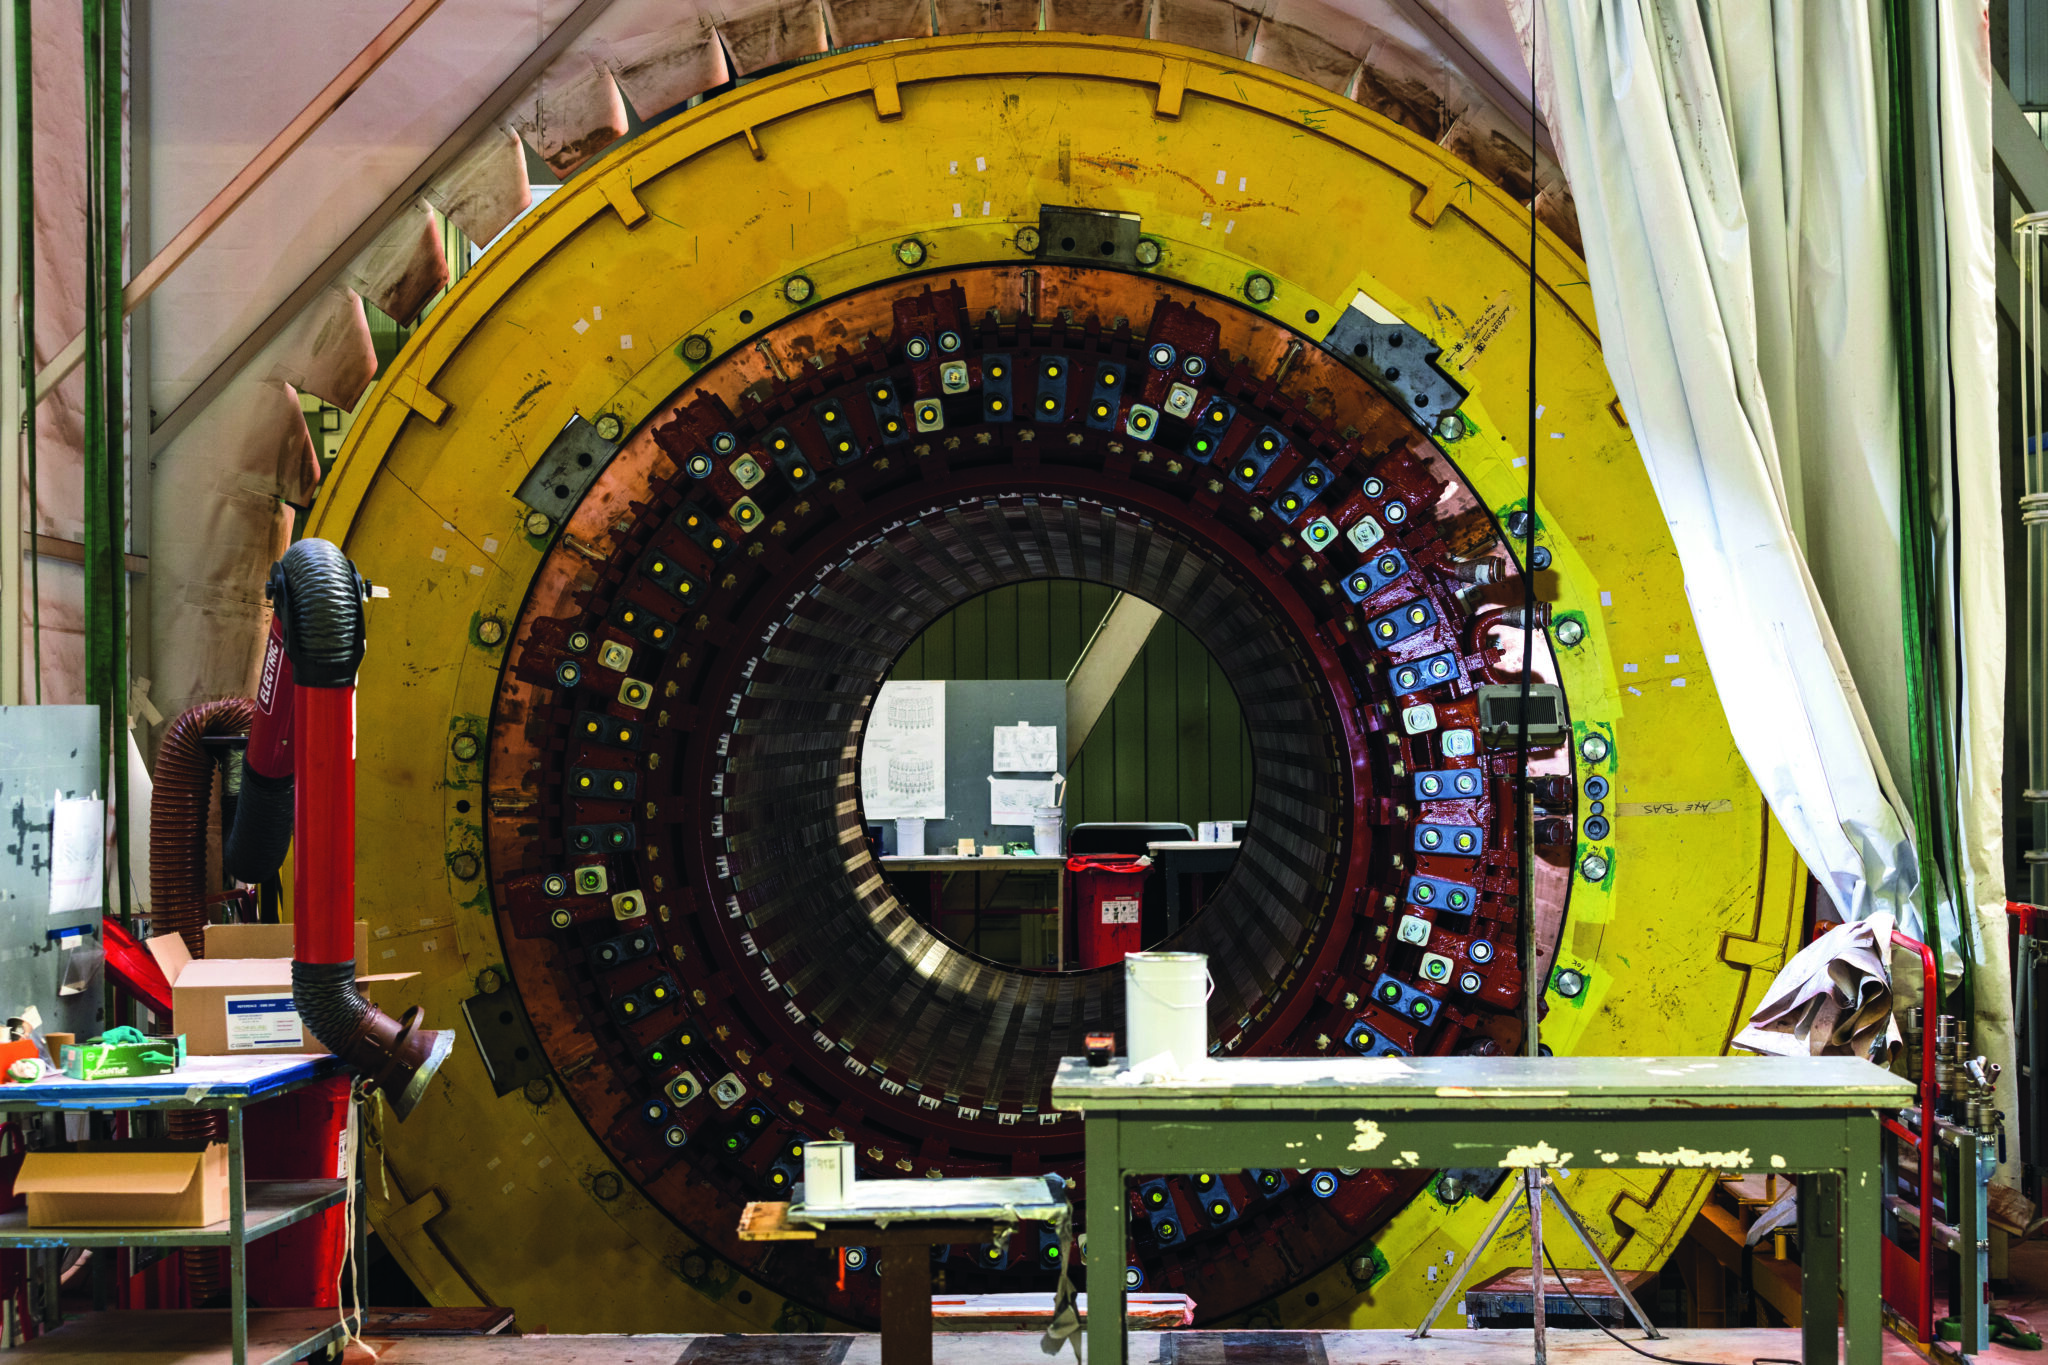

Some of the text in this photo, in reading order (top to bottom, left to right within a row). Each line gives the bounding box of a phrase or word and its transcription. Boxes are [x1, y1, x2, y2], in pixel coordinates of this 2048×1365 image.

[259, 639, 279, 704] ELECTRIC
[1643, 801, 1711, 814] AXE BAS
